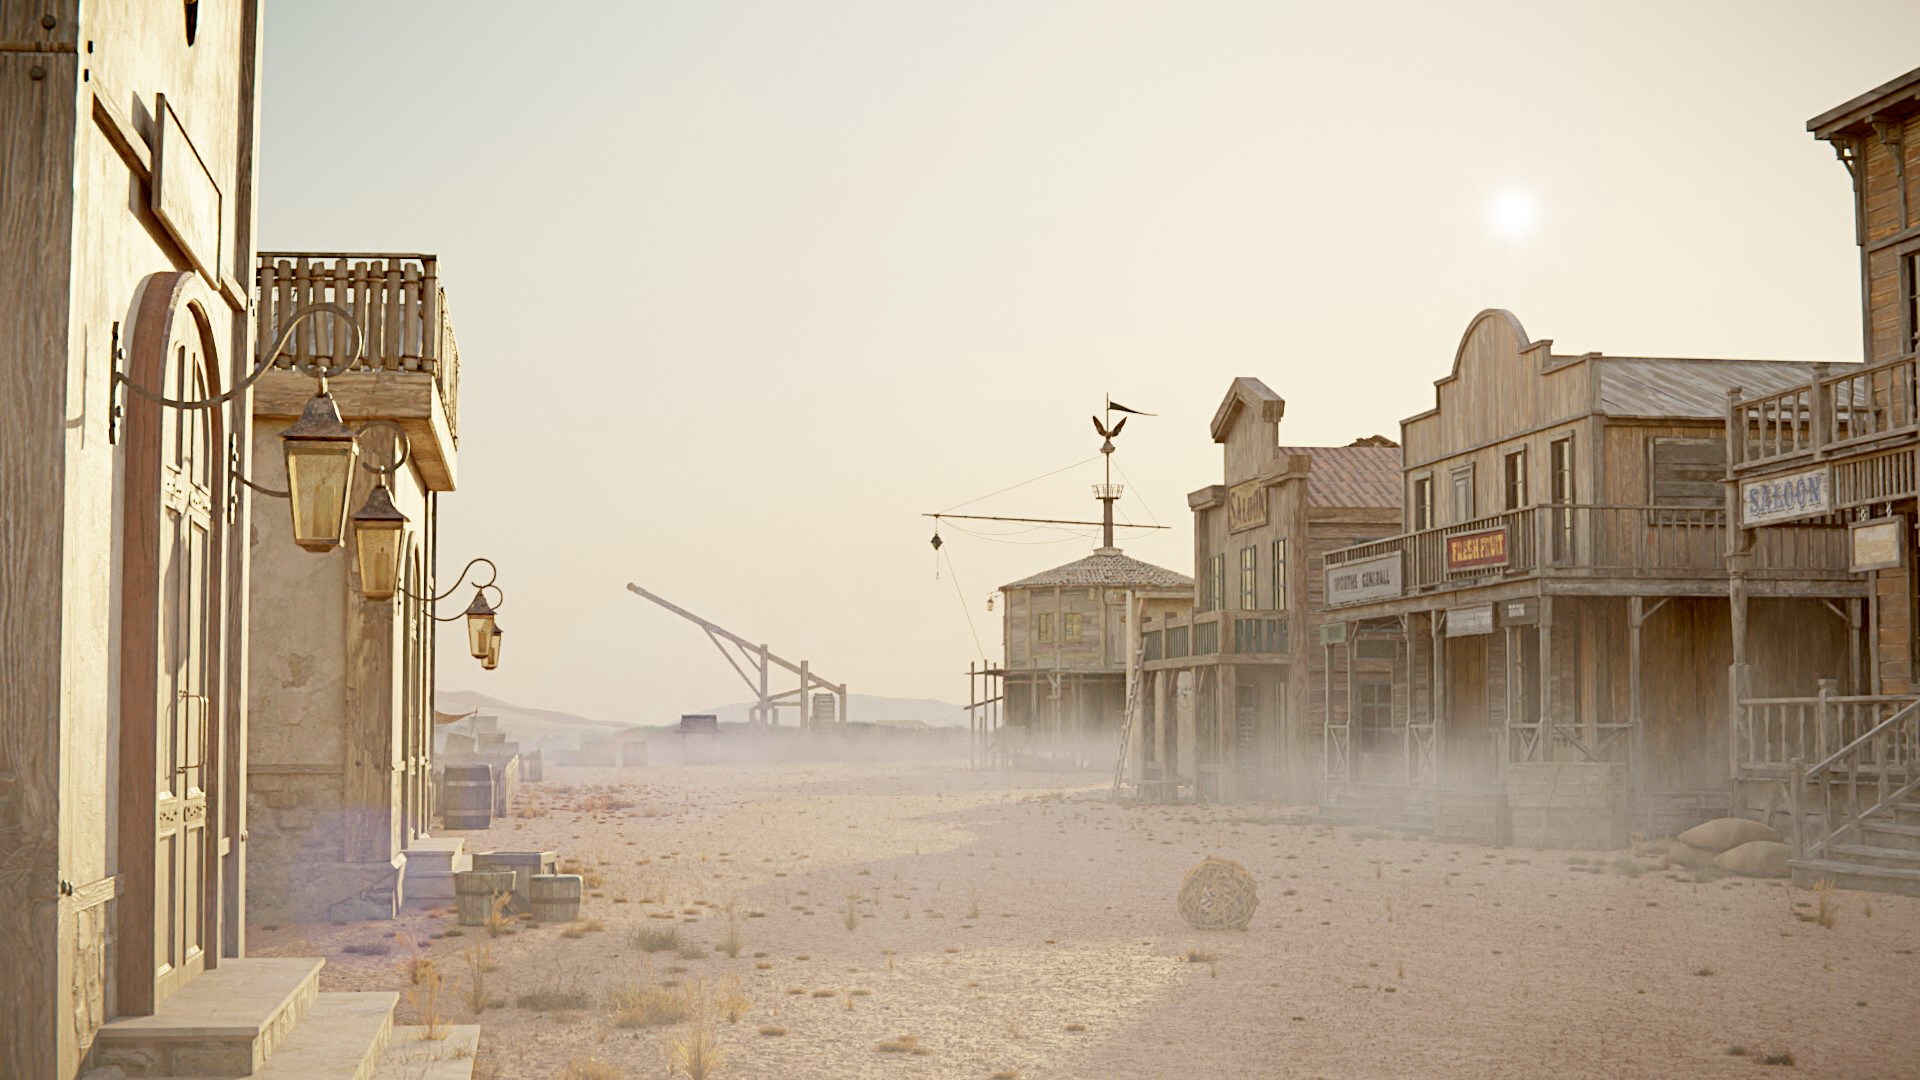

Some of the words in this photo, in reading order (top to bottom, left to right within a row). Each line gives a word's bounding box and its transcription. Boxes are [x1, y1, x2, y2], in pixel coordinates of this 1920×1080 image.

[1230, 486, 1266, 529] SALOON
[1748, 474, 1821, 516] SALOON
[1451, 538, 1479, 562] FRESH
[1480, 534, 1504, 558] FRUIT
